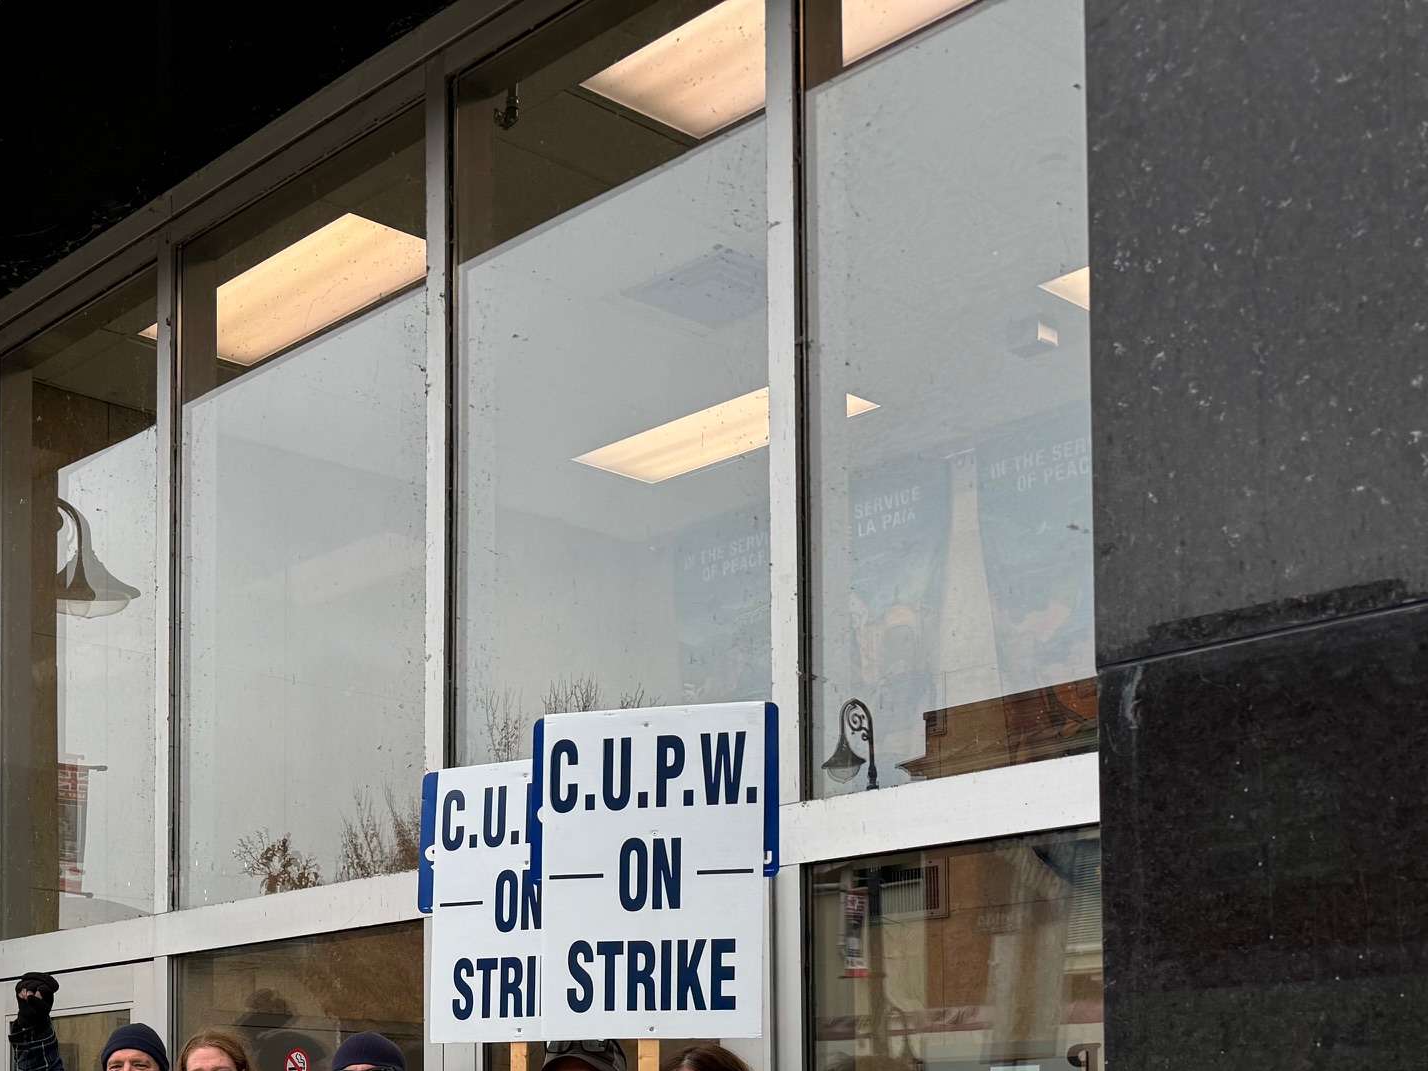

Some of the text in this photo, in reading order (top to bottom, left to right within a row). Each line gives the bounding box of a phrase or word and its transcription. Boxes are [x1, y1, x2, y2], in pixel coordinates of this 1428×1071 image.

[1013, 449, 1045, 472] THE
[1017, 470, 1037, 492] OF
[854, 485, 922, 520] SERVICE
[857, 518, 877, 537] LA
[700, 546, 725, 565] THE
[549, 731, 758, 814] C.U.P.W.
[618, 837, 682, 912] ON
[494, 869, 542, 933] ON
[452, 955, 542, 1021] STRI
[566, 938, 737, 1013] STRIKE
